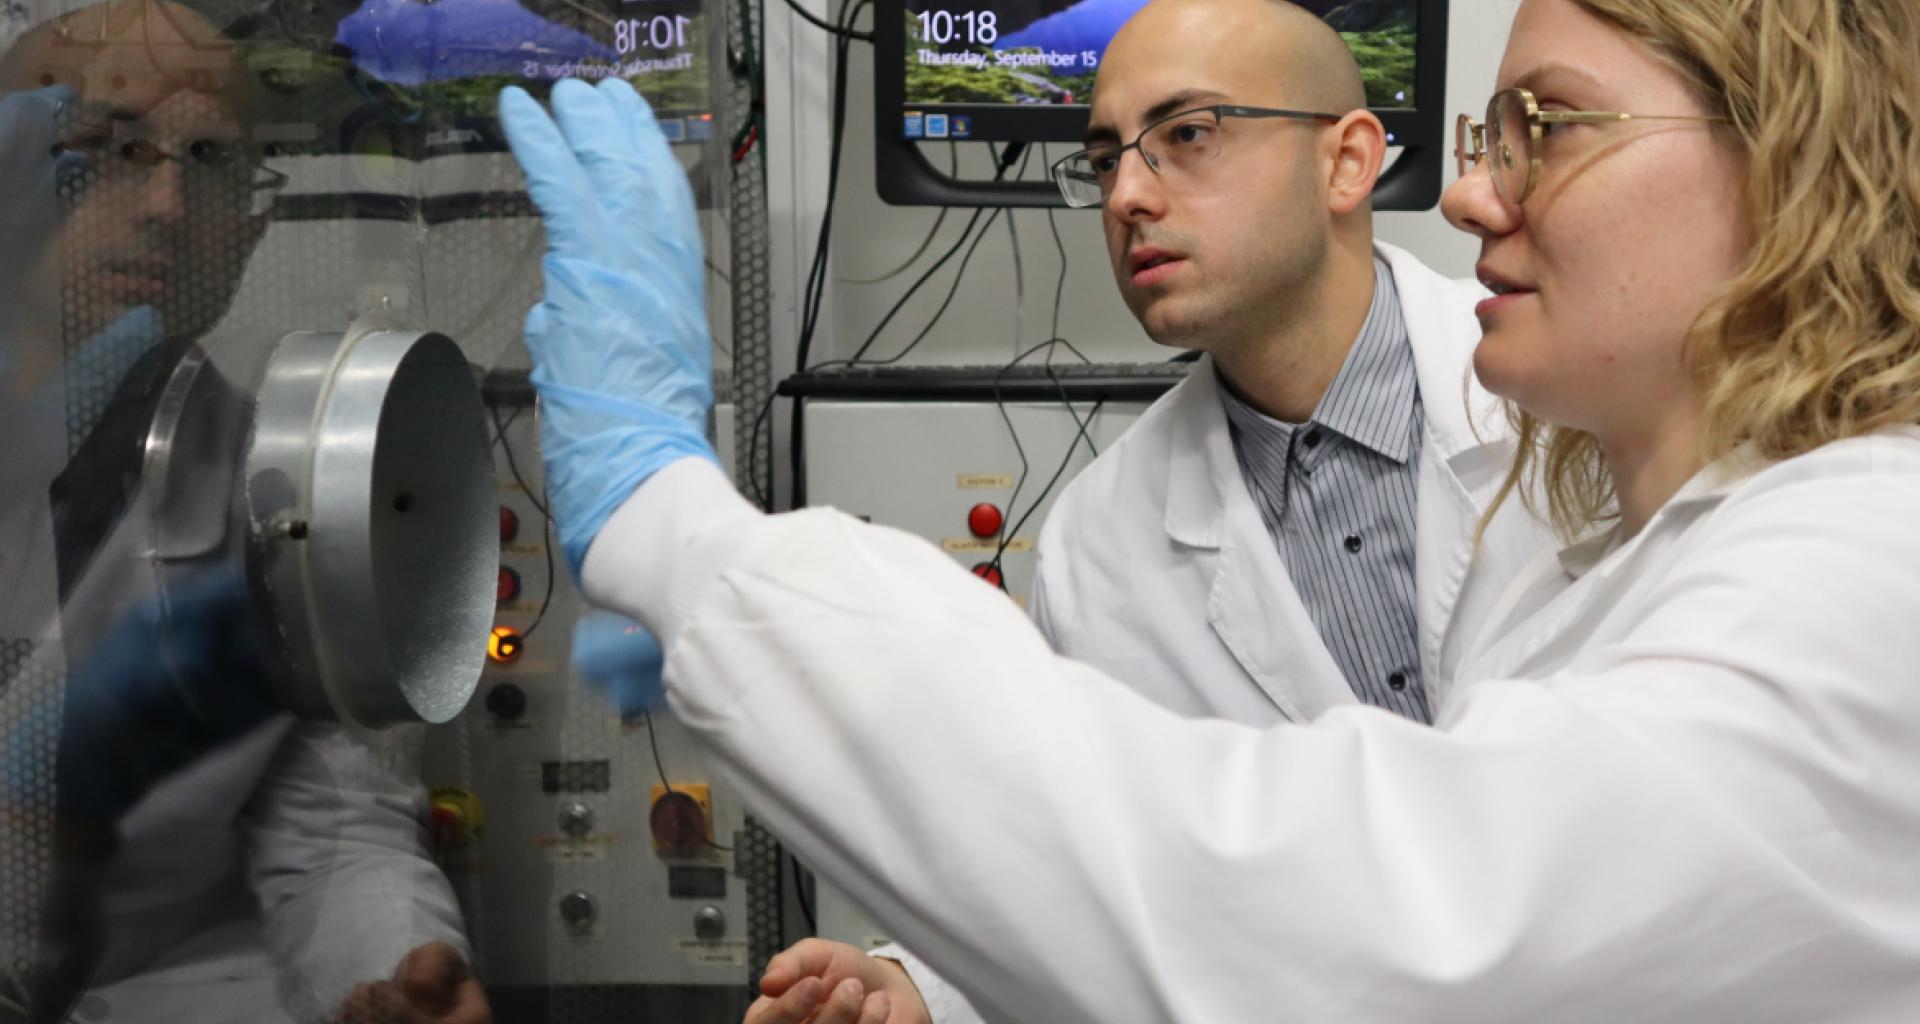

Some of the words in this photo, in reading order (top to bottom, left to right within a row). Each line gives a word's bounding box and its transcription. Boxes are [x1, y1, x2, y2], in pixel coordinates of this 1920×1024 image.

[917, 10, 998, 44] 10:18
[917, 49, 990, 69] Thursday,
[994, 50, 1077, 69] September
[1081, 51, 1097, 66] 15
